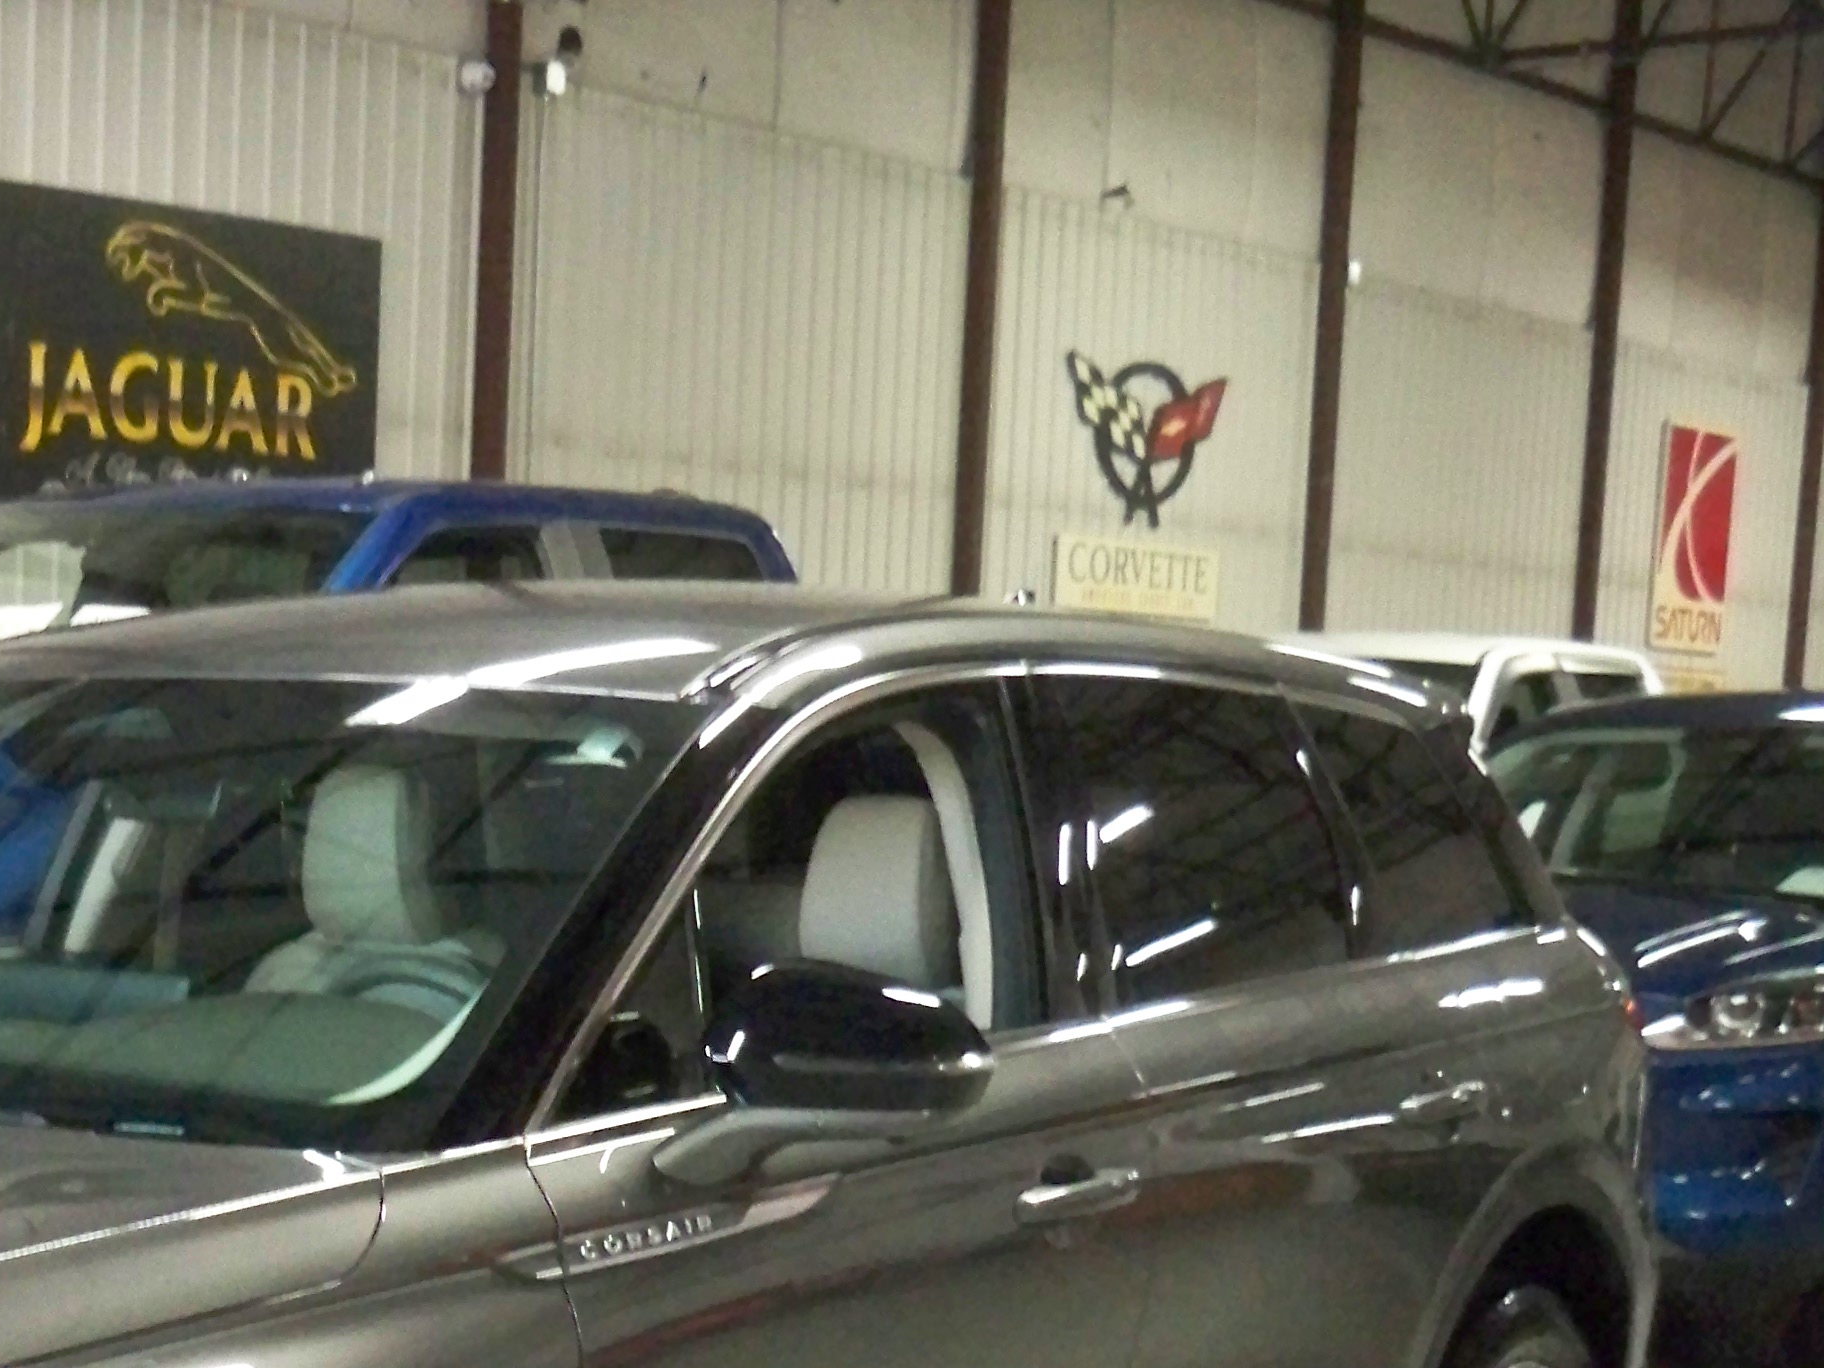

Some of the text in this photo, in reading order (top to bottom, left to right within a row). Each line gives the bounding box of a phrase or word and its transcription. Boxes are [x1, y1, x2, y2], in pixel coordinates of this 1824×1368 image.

[19, 339, 316, 461] JAGUAR
[1068, 541, 1210, 594] CORVETTE
[1656, 604, 1721, 643] SATURN
